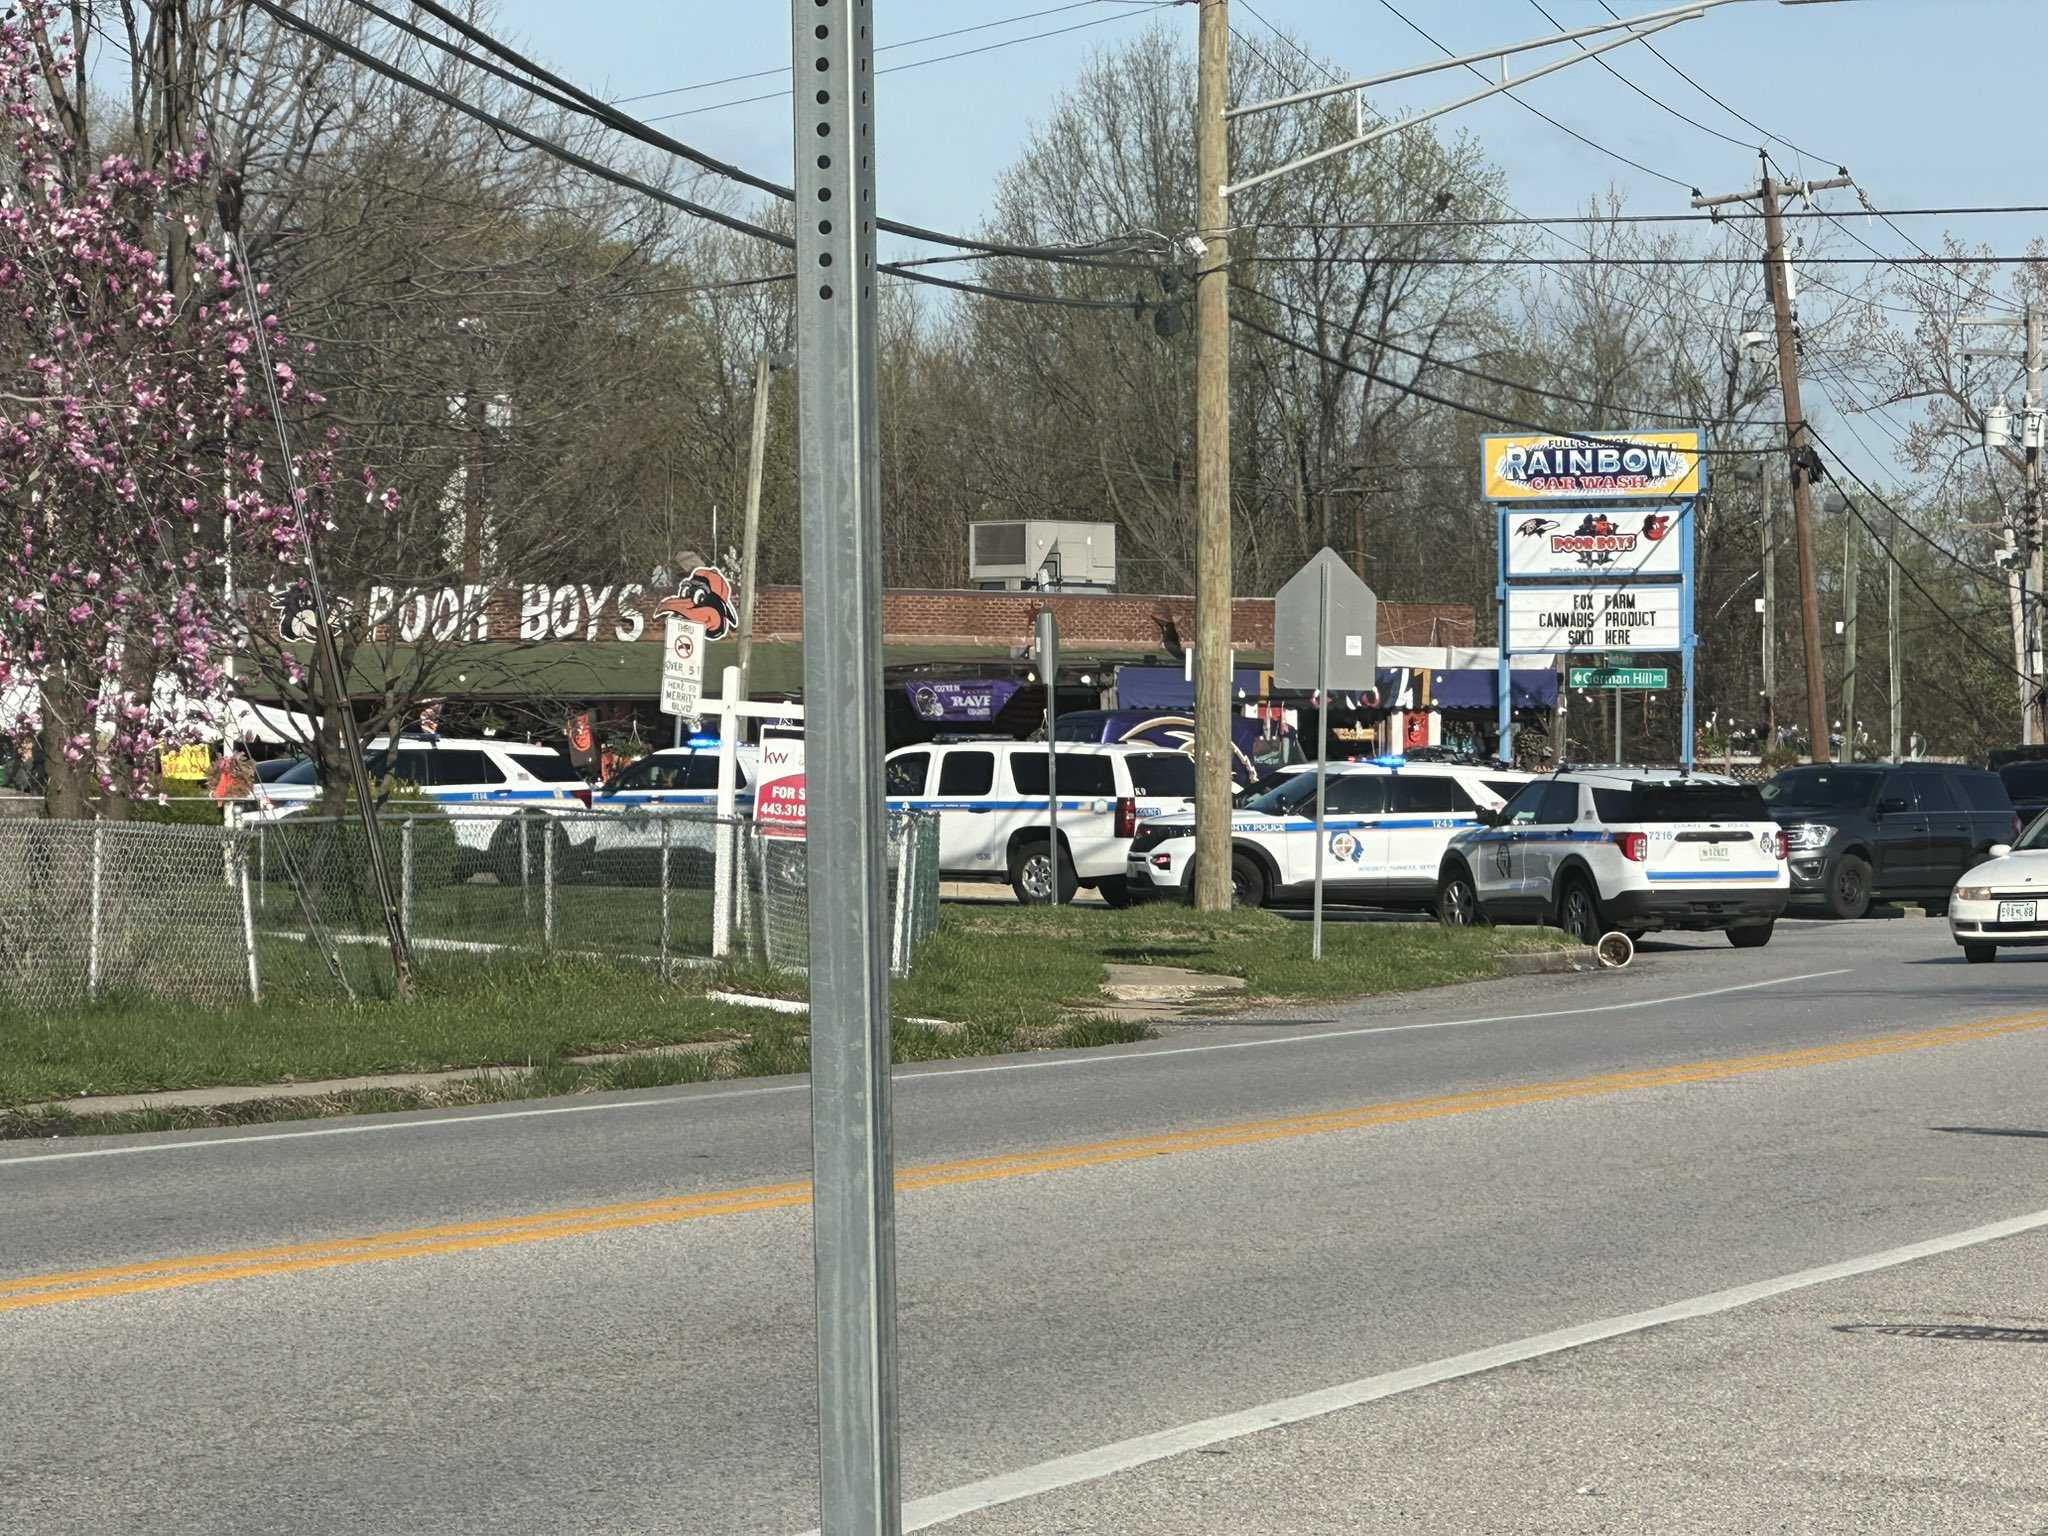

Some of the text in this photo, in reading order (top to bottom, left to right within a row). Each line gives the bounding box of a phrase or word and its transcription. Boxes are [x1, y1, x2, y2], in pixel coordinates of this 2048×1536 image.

[1505, 444, 1677, 480] RAINBOW
[1532, 474, 1649, 490] CAR WASH
[1553, 537, 1594, 551] POOR
[1574, 594, 1635, 610] FOX FARM
[520, 584, 645, 643] BOYS
[1539, 611, 1656, 627] CANNABIS PRODUCT
[1568, 630, 1631, 645] SOLD HERE
[1633, 672, 1652, 684] Hill
[764, 747, 789, 763] kw
[772, 785, 795, 799] FOR
[761, 801, 806, 816] 443.318
[1649, 831, 1673, 841] 7216
